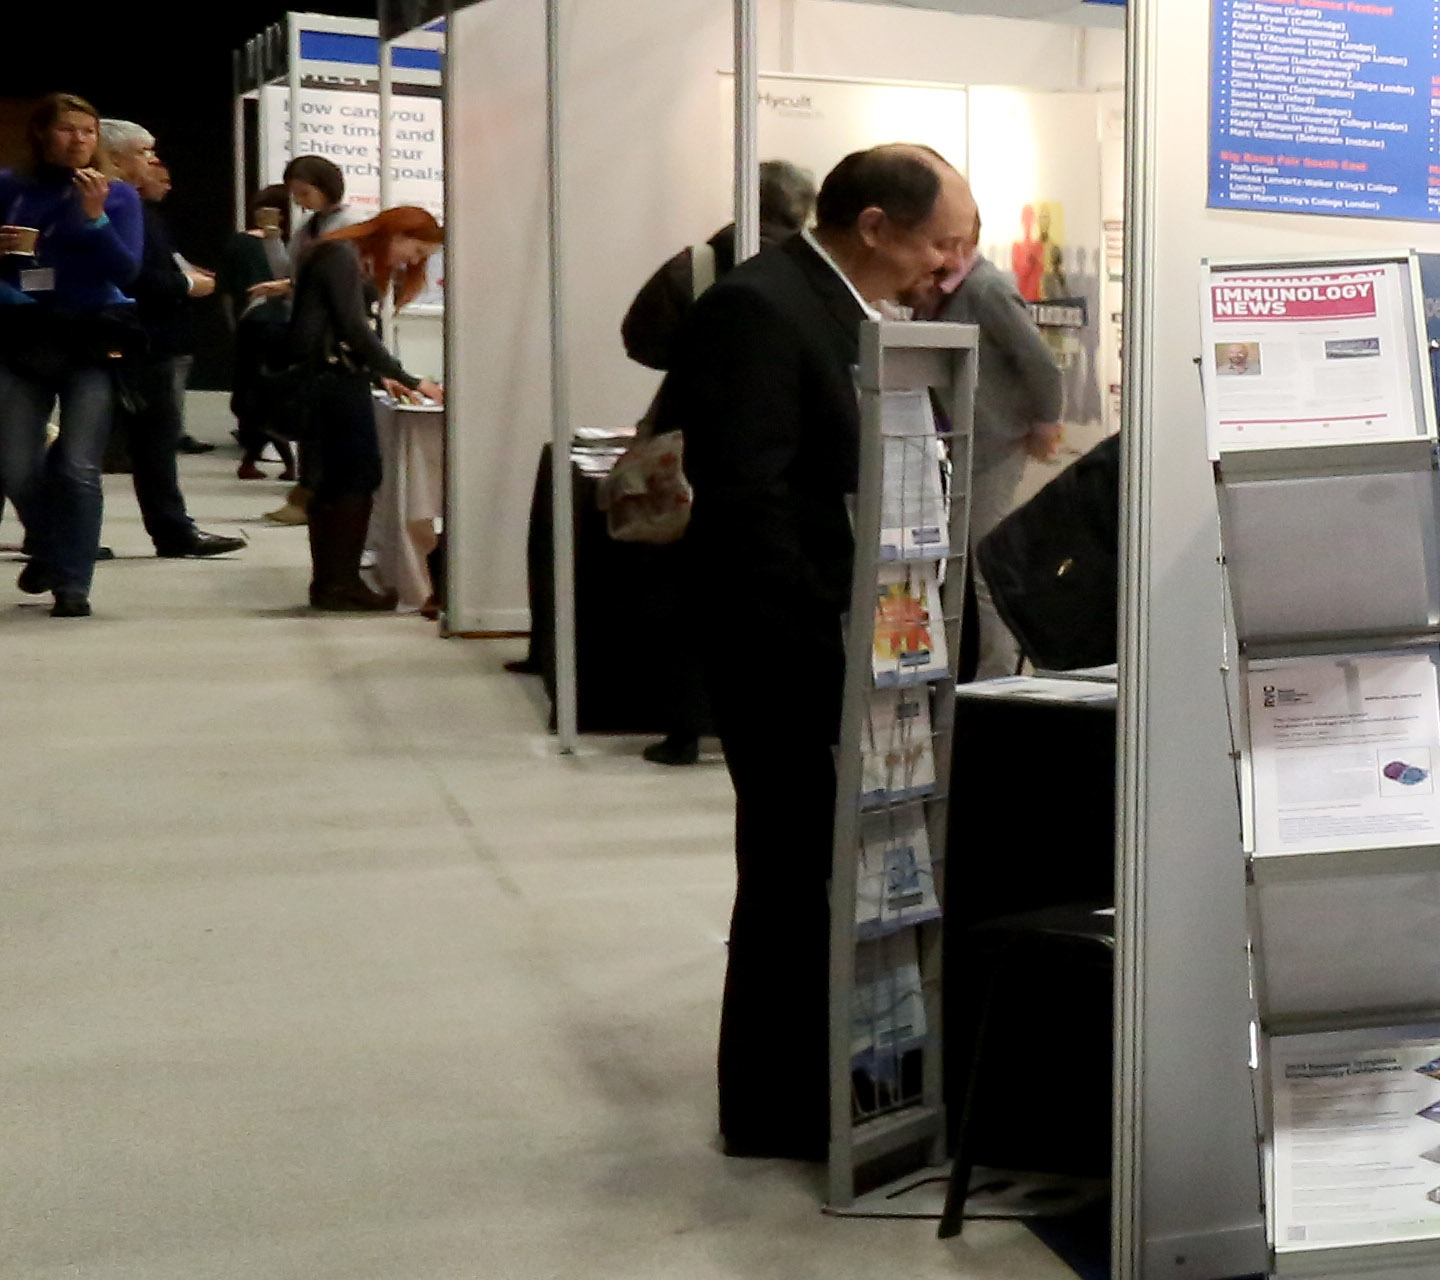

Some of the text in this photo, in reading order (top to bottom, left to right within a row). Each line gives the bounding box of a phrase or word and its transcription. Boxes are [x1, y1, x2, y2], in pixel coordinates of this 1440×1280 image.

[396, 129, 434, 142] and
[1215, 283, 1371, 302] IMMUNOLOGY
[1216, 301, 1287, 315] NEWS
